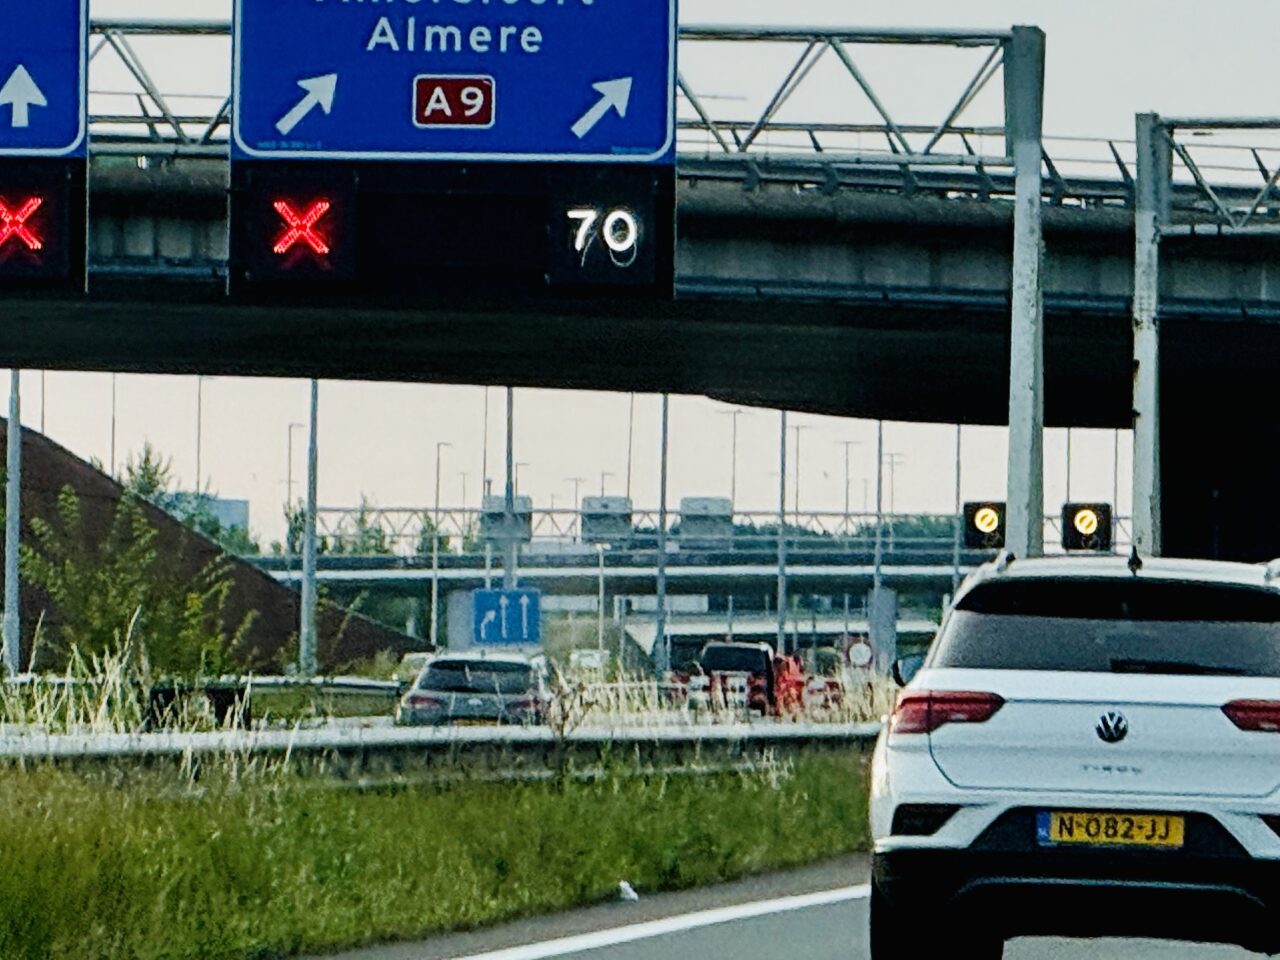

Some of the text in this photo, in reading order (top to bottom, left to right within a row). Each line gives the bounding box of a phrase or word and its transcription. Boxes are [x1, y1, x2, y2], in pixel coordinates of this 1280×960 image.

[366, 16, 544, 54] Almere
[423, 86, 485, 118] A9
[566, 209, 638, 253] 70
[1057, 815, 1171, 841] N-082-JJ
